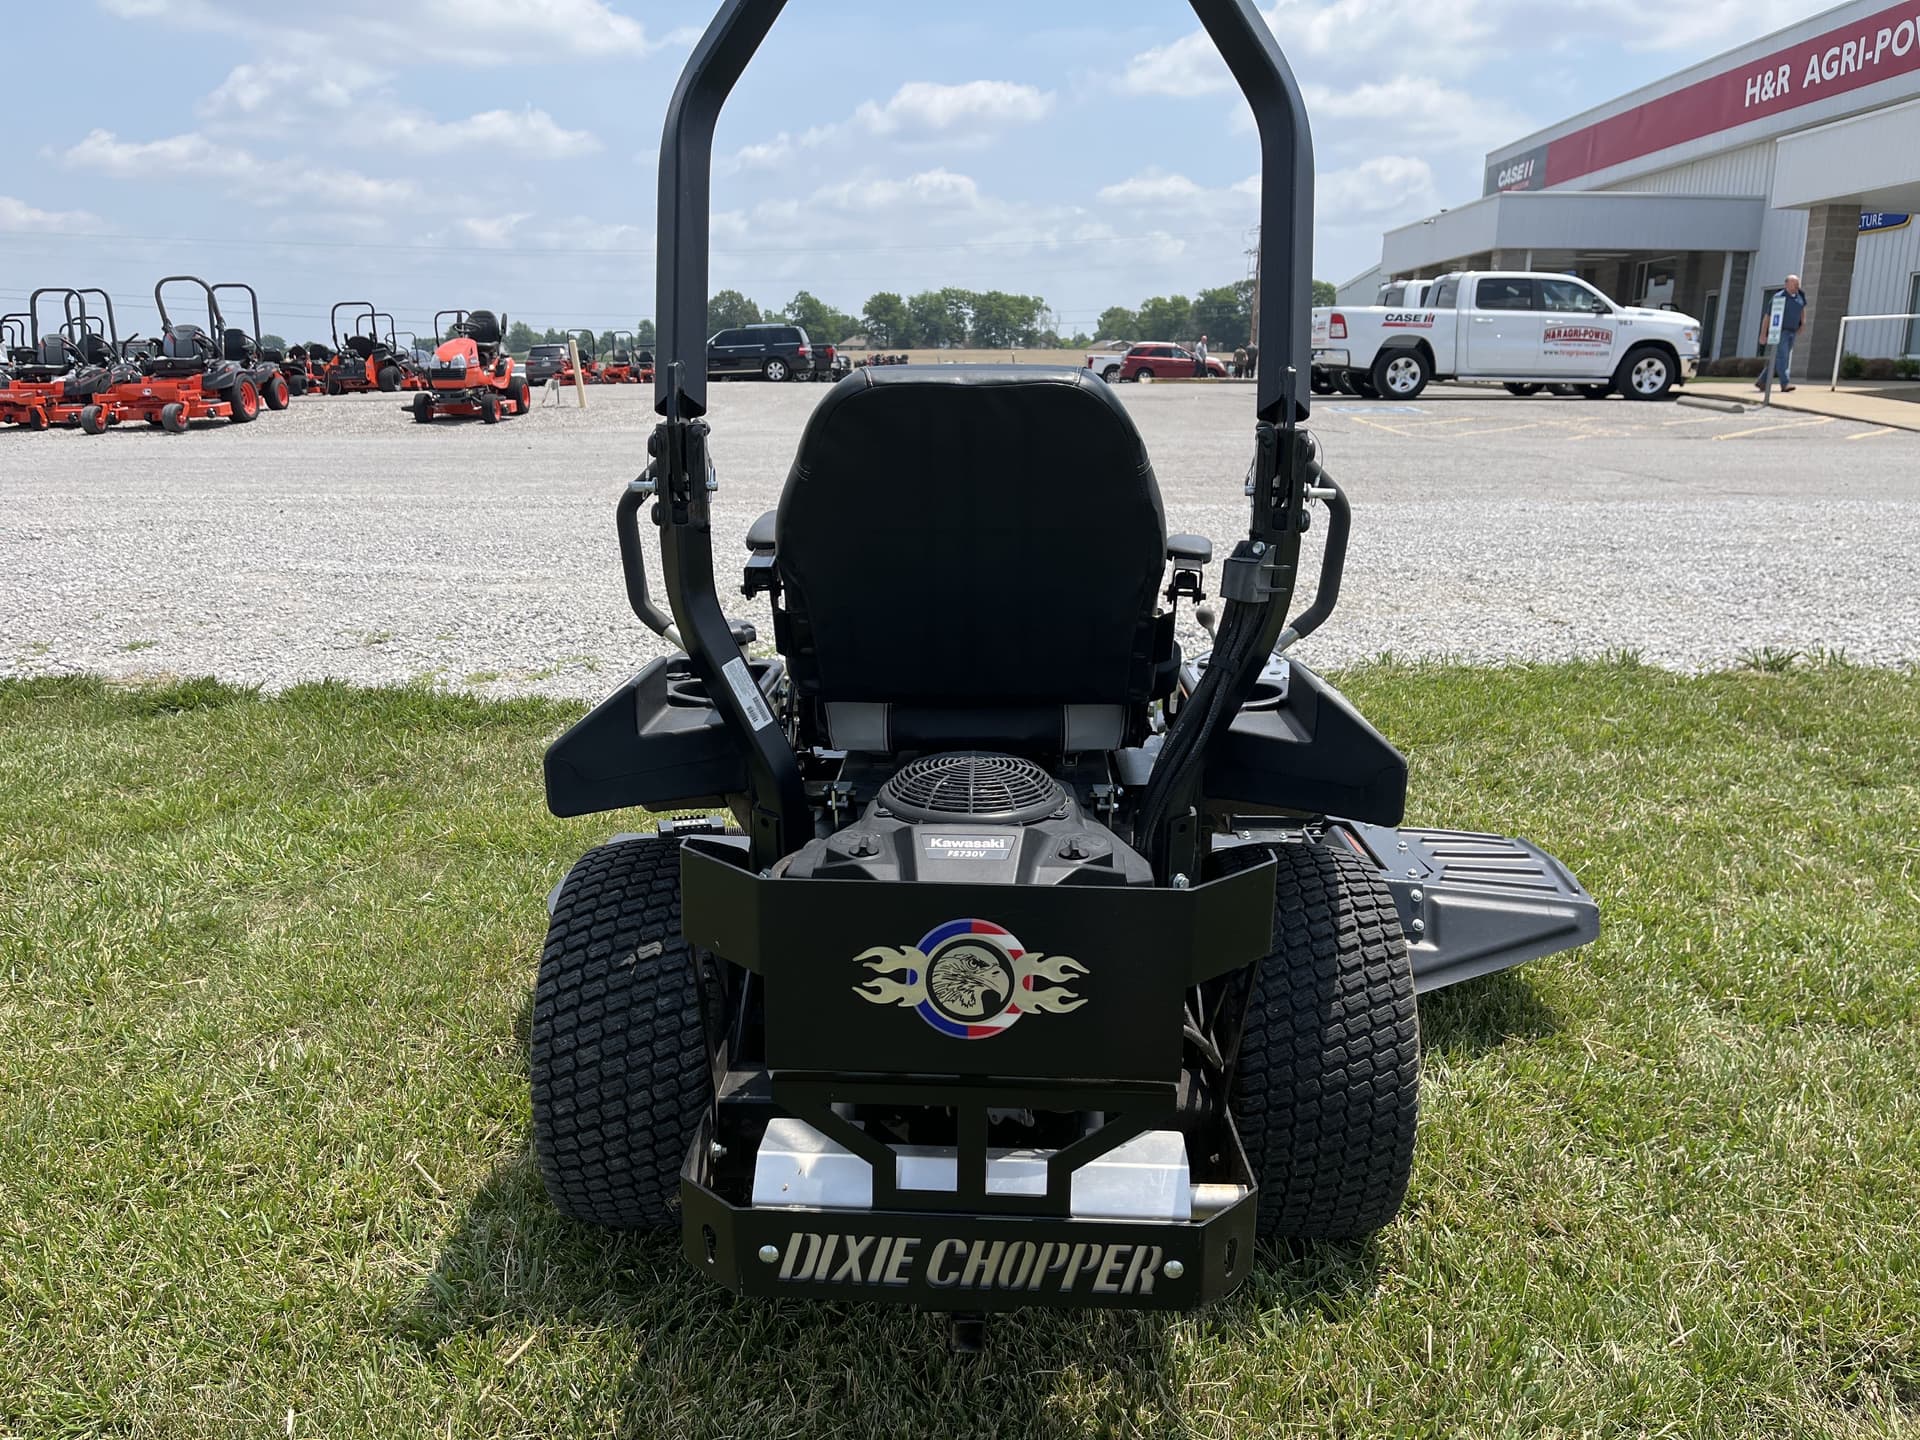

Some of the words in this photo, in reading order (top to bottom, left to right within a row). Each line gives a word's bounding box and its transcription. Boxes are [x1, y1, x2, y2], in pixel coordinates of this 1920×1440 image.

[1744, 63, 1791, 108] H&R
[1802, 15, 1920, 89] AGRI-PO
[1497, 162, 1525, 188] CASE
[1384, 313, 1423, 322] CASE
[1563, 327, 1611, 341] AGRI-POWER
[930, 838, 1005, 849] Kawasaki
[947, 850, 987, 858] FS730V
[777, 1232, 922, 1285] DIXIE
[925, 1237, 1164, 1296] CHOPPER
